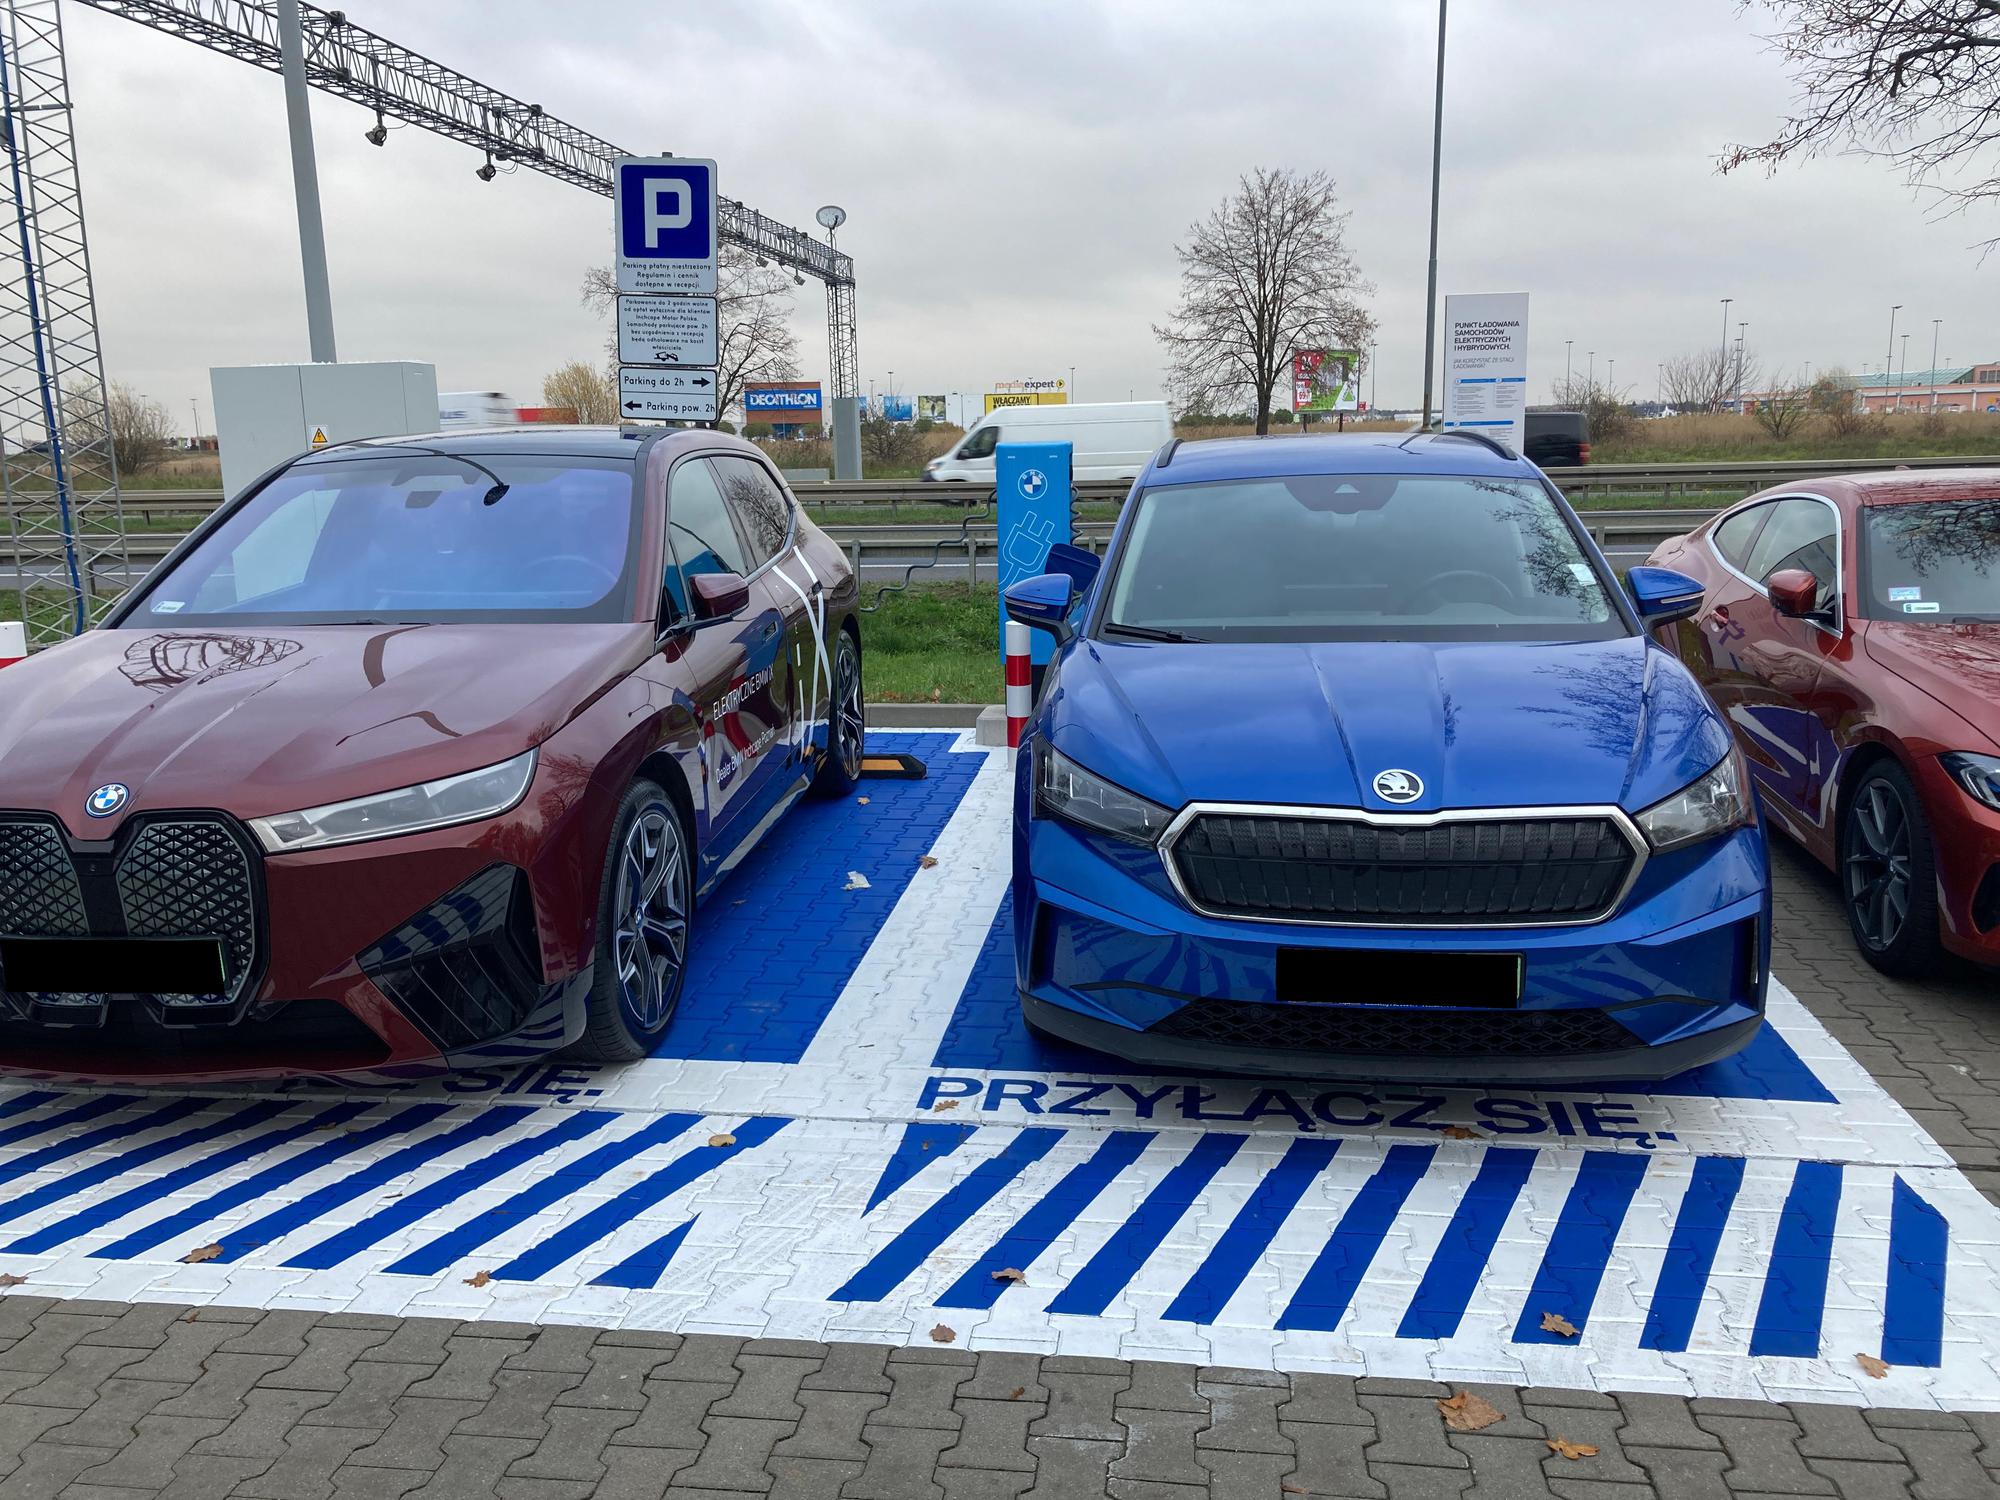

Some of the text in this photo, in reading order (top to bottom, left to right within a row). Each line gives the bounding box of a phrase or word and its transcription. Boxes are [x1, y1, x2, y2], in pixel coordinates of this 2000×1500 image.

[643, 177, 692, 248] P
[622, 262, 647, 270] Parking
[649, 262, 670, 270] płatny
[637, 271, 671, 279] Regulamin
[635, 281, 665, 289] dostępne
[626, 321, 657, 329] Samochody
[1454, 320, 1520, 329] PUNKT ŁADOWANIA
[1454, 328, 1505, 337] SAMOCHODÓW
[1454, 336, 1511, 344] ELEKTRYCZNYCH
[624, 375, 685, 387] Parking do 2h
[749, 392, 817, 406] DECATHLON
[646, 401, 716, 414] Parking pow. 2h
[755, 666, 769, 691] BMW
[716, 762, 731, 784] Dealer
[731, 750, 744, 771] BMW
[916, 1076, 1678, 1149] PRZYŁĄCZ SIĘ.
